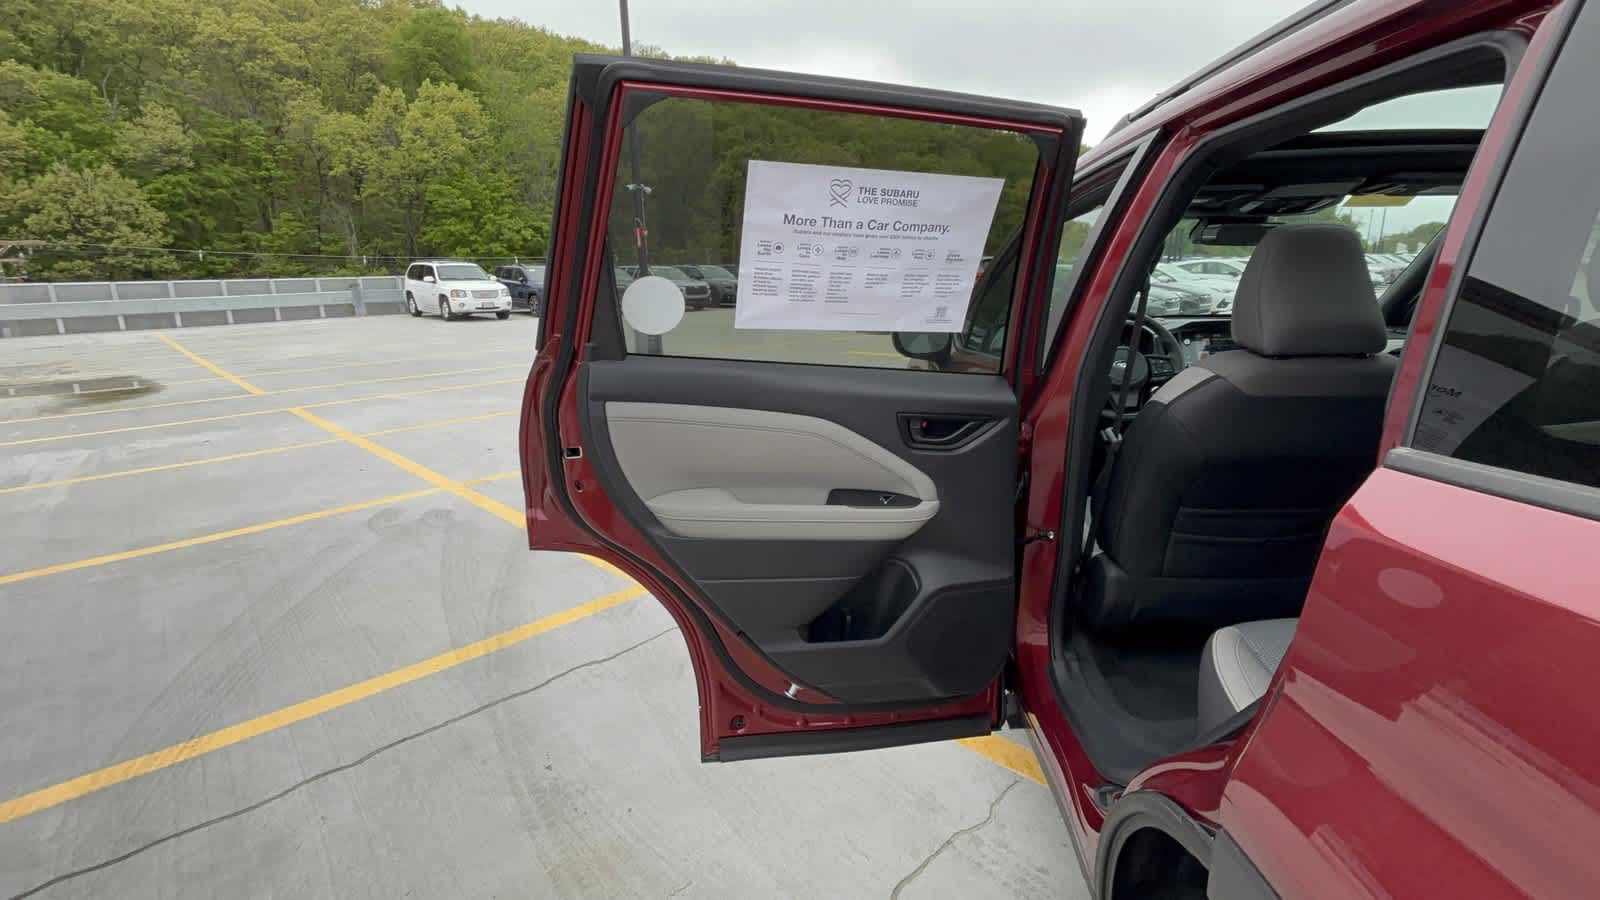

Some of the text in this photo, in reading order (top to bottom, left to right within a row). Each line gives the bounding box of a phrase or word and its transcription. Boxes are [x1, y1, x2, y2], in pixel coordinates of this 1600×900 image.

[859, 186, 919, 199] THE SUBARU
[857, 196, 918, 208] LOVE PROMISE
[783, 213, 817, 227] More
[821, 216, 852, 230] Than
[856, 220, 864, 230] a
[867, 219, 889, 231] Car
[893, 220, 951, 235] Company.
